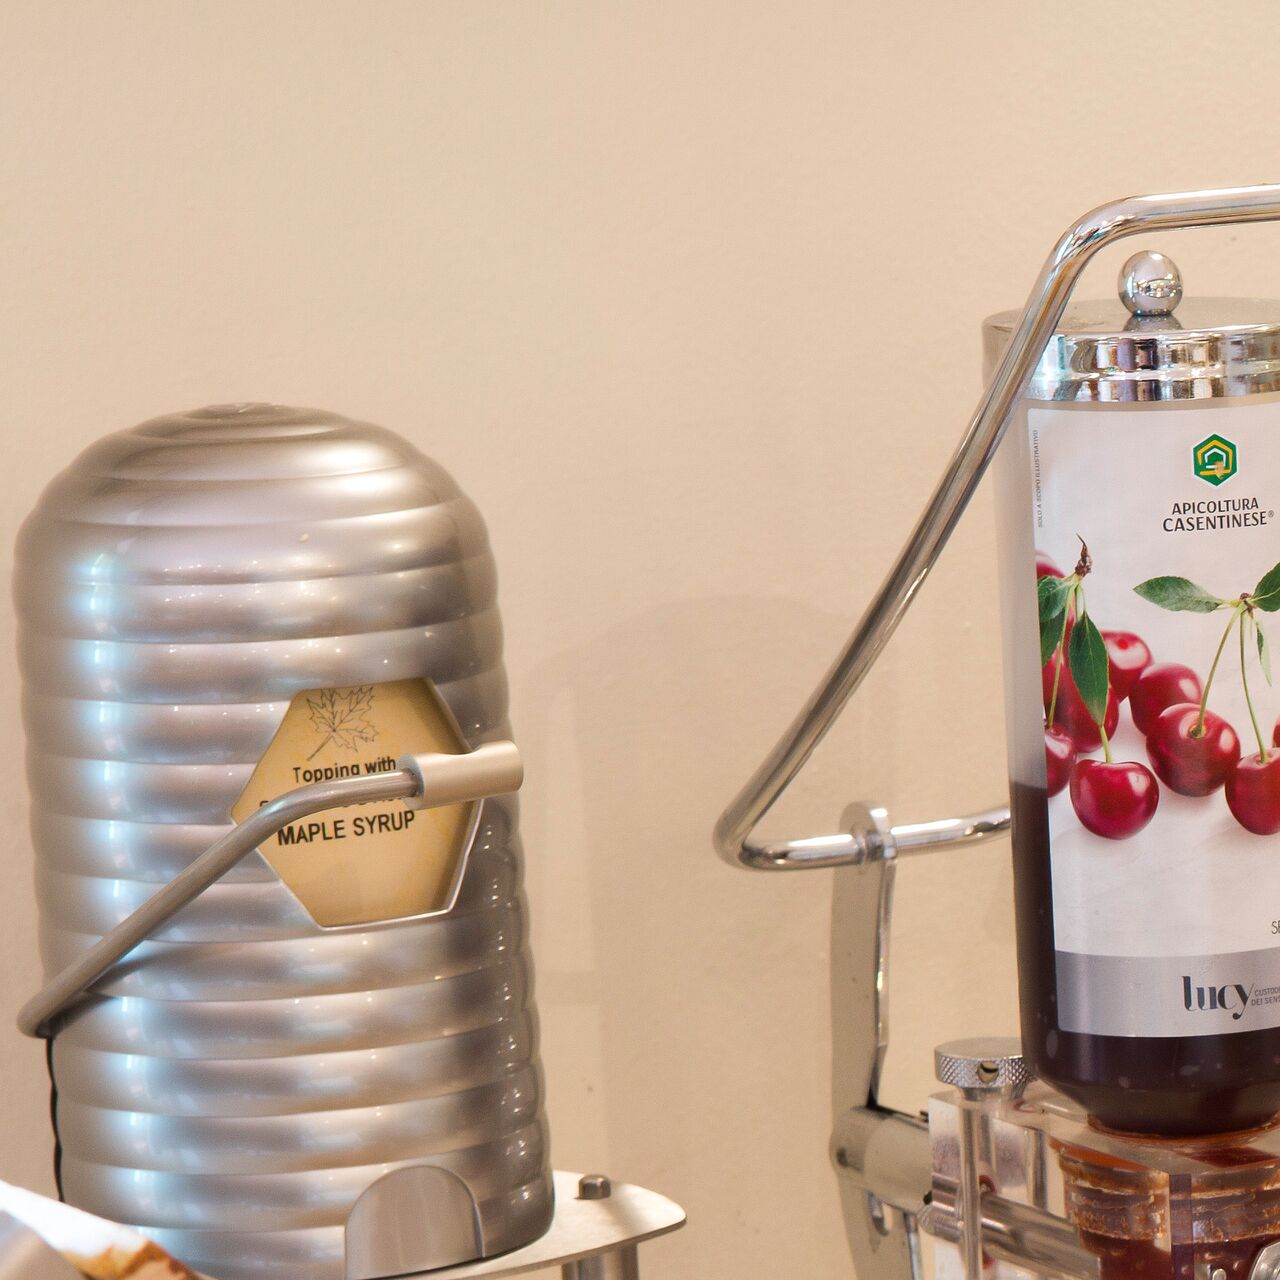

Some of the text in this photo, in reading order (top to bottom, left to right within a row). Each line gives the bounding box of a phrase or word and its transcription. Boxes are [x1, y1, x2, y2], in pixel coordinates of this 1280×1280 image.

[1172, 497, 1259, 515] APICOLTURA
[293, 756, 396, 783] Topping with
[277, 810, 415, 846] MAPLE SYRUP
[1181, 975, 1255, 1020] lucy
[1251, 998, 1263, 1006] DEI
